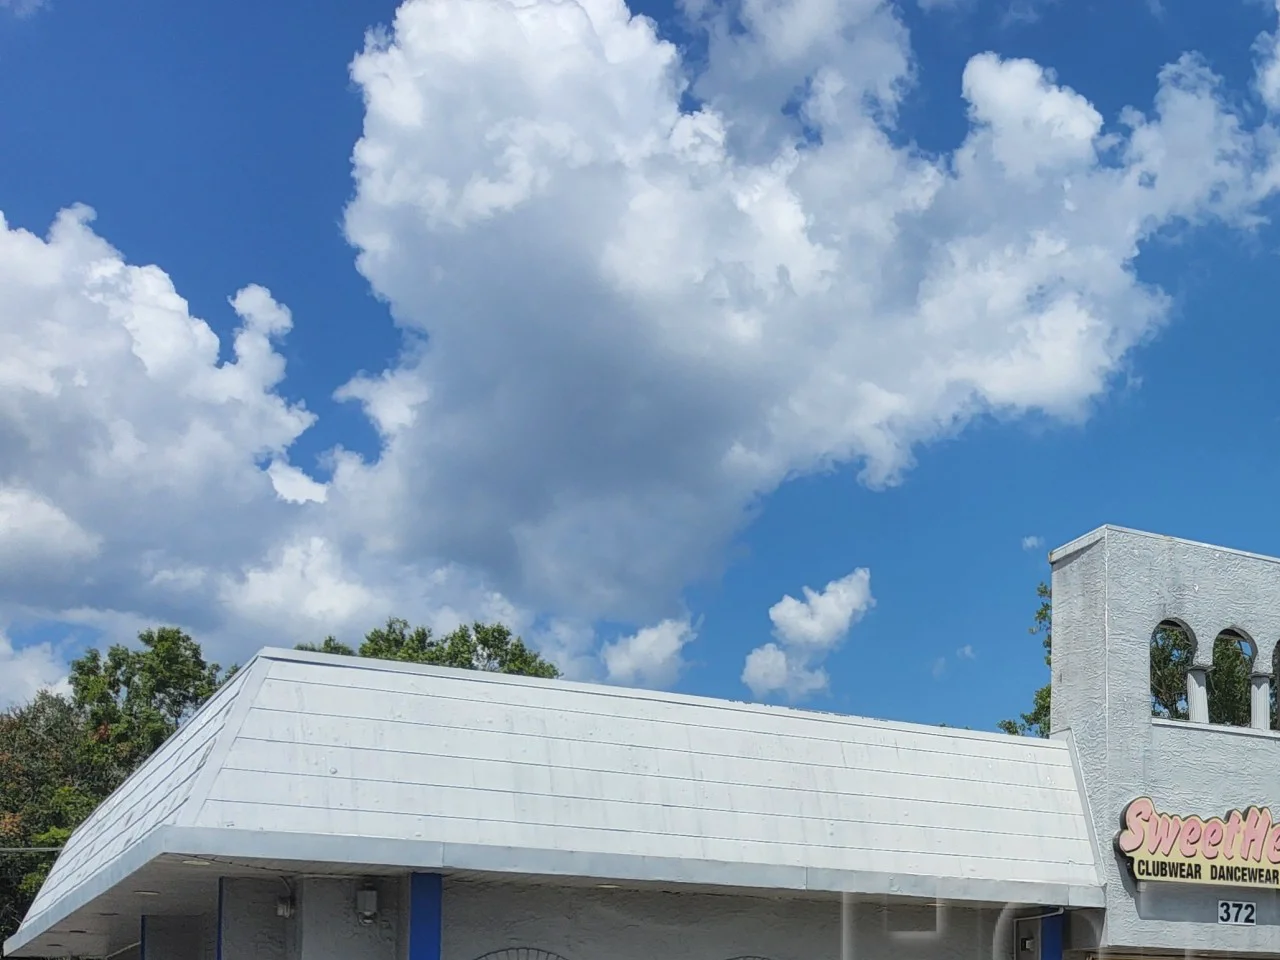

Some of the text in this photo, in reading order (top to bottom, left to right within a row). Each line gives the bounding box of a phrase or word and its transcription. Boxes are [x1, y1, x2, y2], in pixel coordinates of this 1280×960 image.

[1137, 859, 1202, 880] CLUBWEAR
[1210, 864, 1280, 885] DANCEWEAR
[1219, 902, 1256, 924] 372
